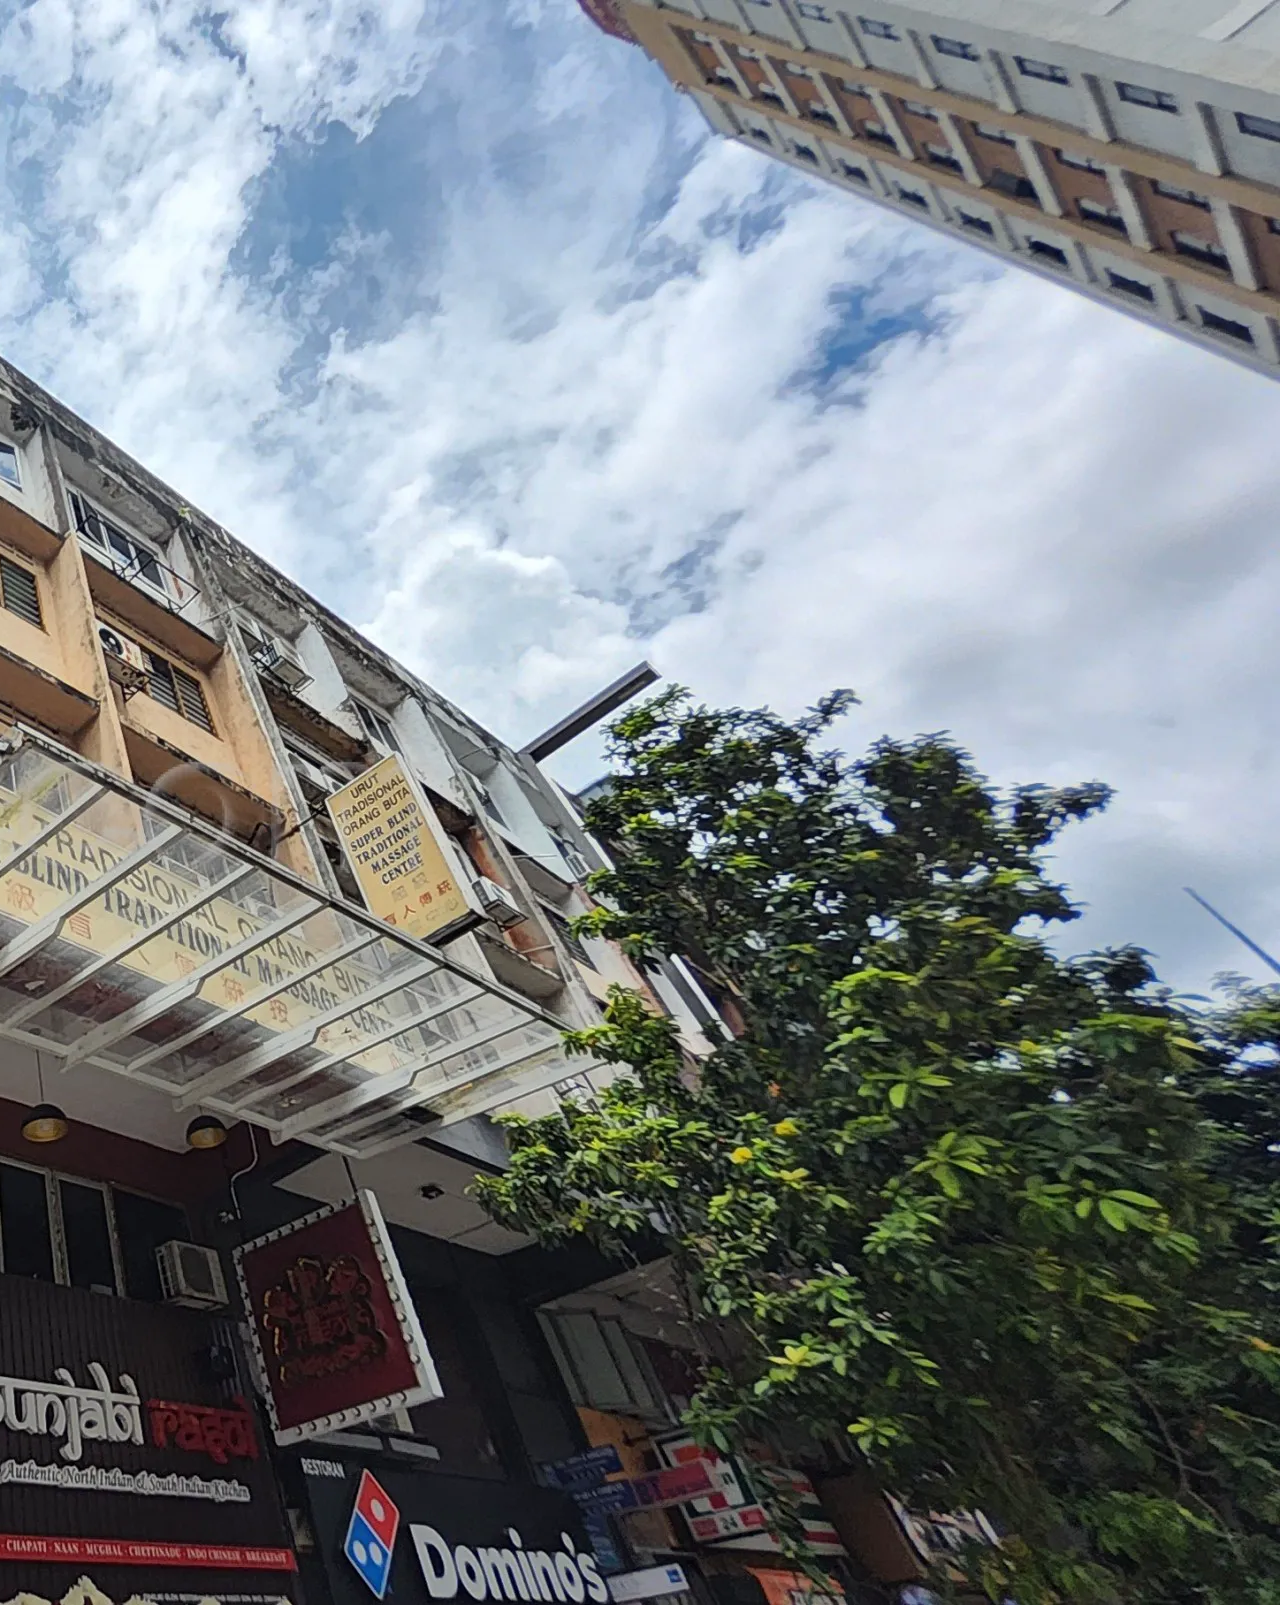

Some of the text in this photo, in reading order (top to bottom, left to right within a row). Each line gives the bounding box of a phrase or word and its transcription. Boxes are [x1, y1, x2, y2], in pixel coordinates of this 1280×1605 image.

[337, 775, 405, 823] TRADISIONAL
[350, 772, 380, 799] URUT
[342, 787, 411, 836] ORANG BUTA
[350, 801, 417, 852] SUPER BLIND
[356, 817, 424, 865] TRADITIONAL
[371, 835, 422, 874] MASSAGE
[382, 852, 423, 885] CENTRE
[5, 1461, 61, 1483] Authentic
[62, 1467, 97, 1486] North
[99, 1469, 134, 1488] Indian
[149, 1474, 178, 1493] South
[180, 1477, 212, 1496] Indian
[213, 1481, 249, 1499] Kitchen
[301, 1457, 346, 1480] RESTORAN
[6, 1539, 47, 1553] CHAPATI
[54, 1541, 79, 1554] NAAN
[409, 1523, 609, 1603] Domino's
